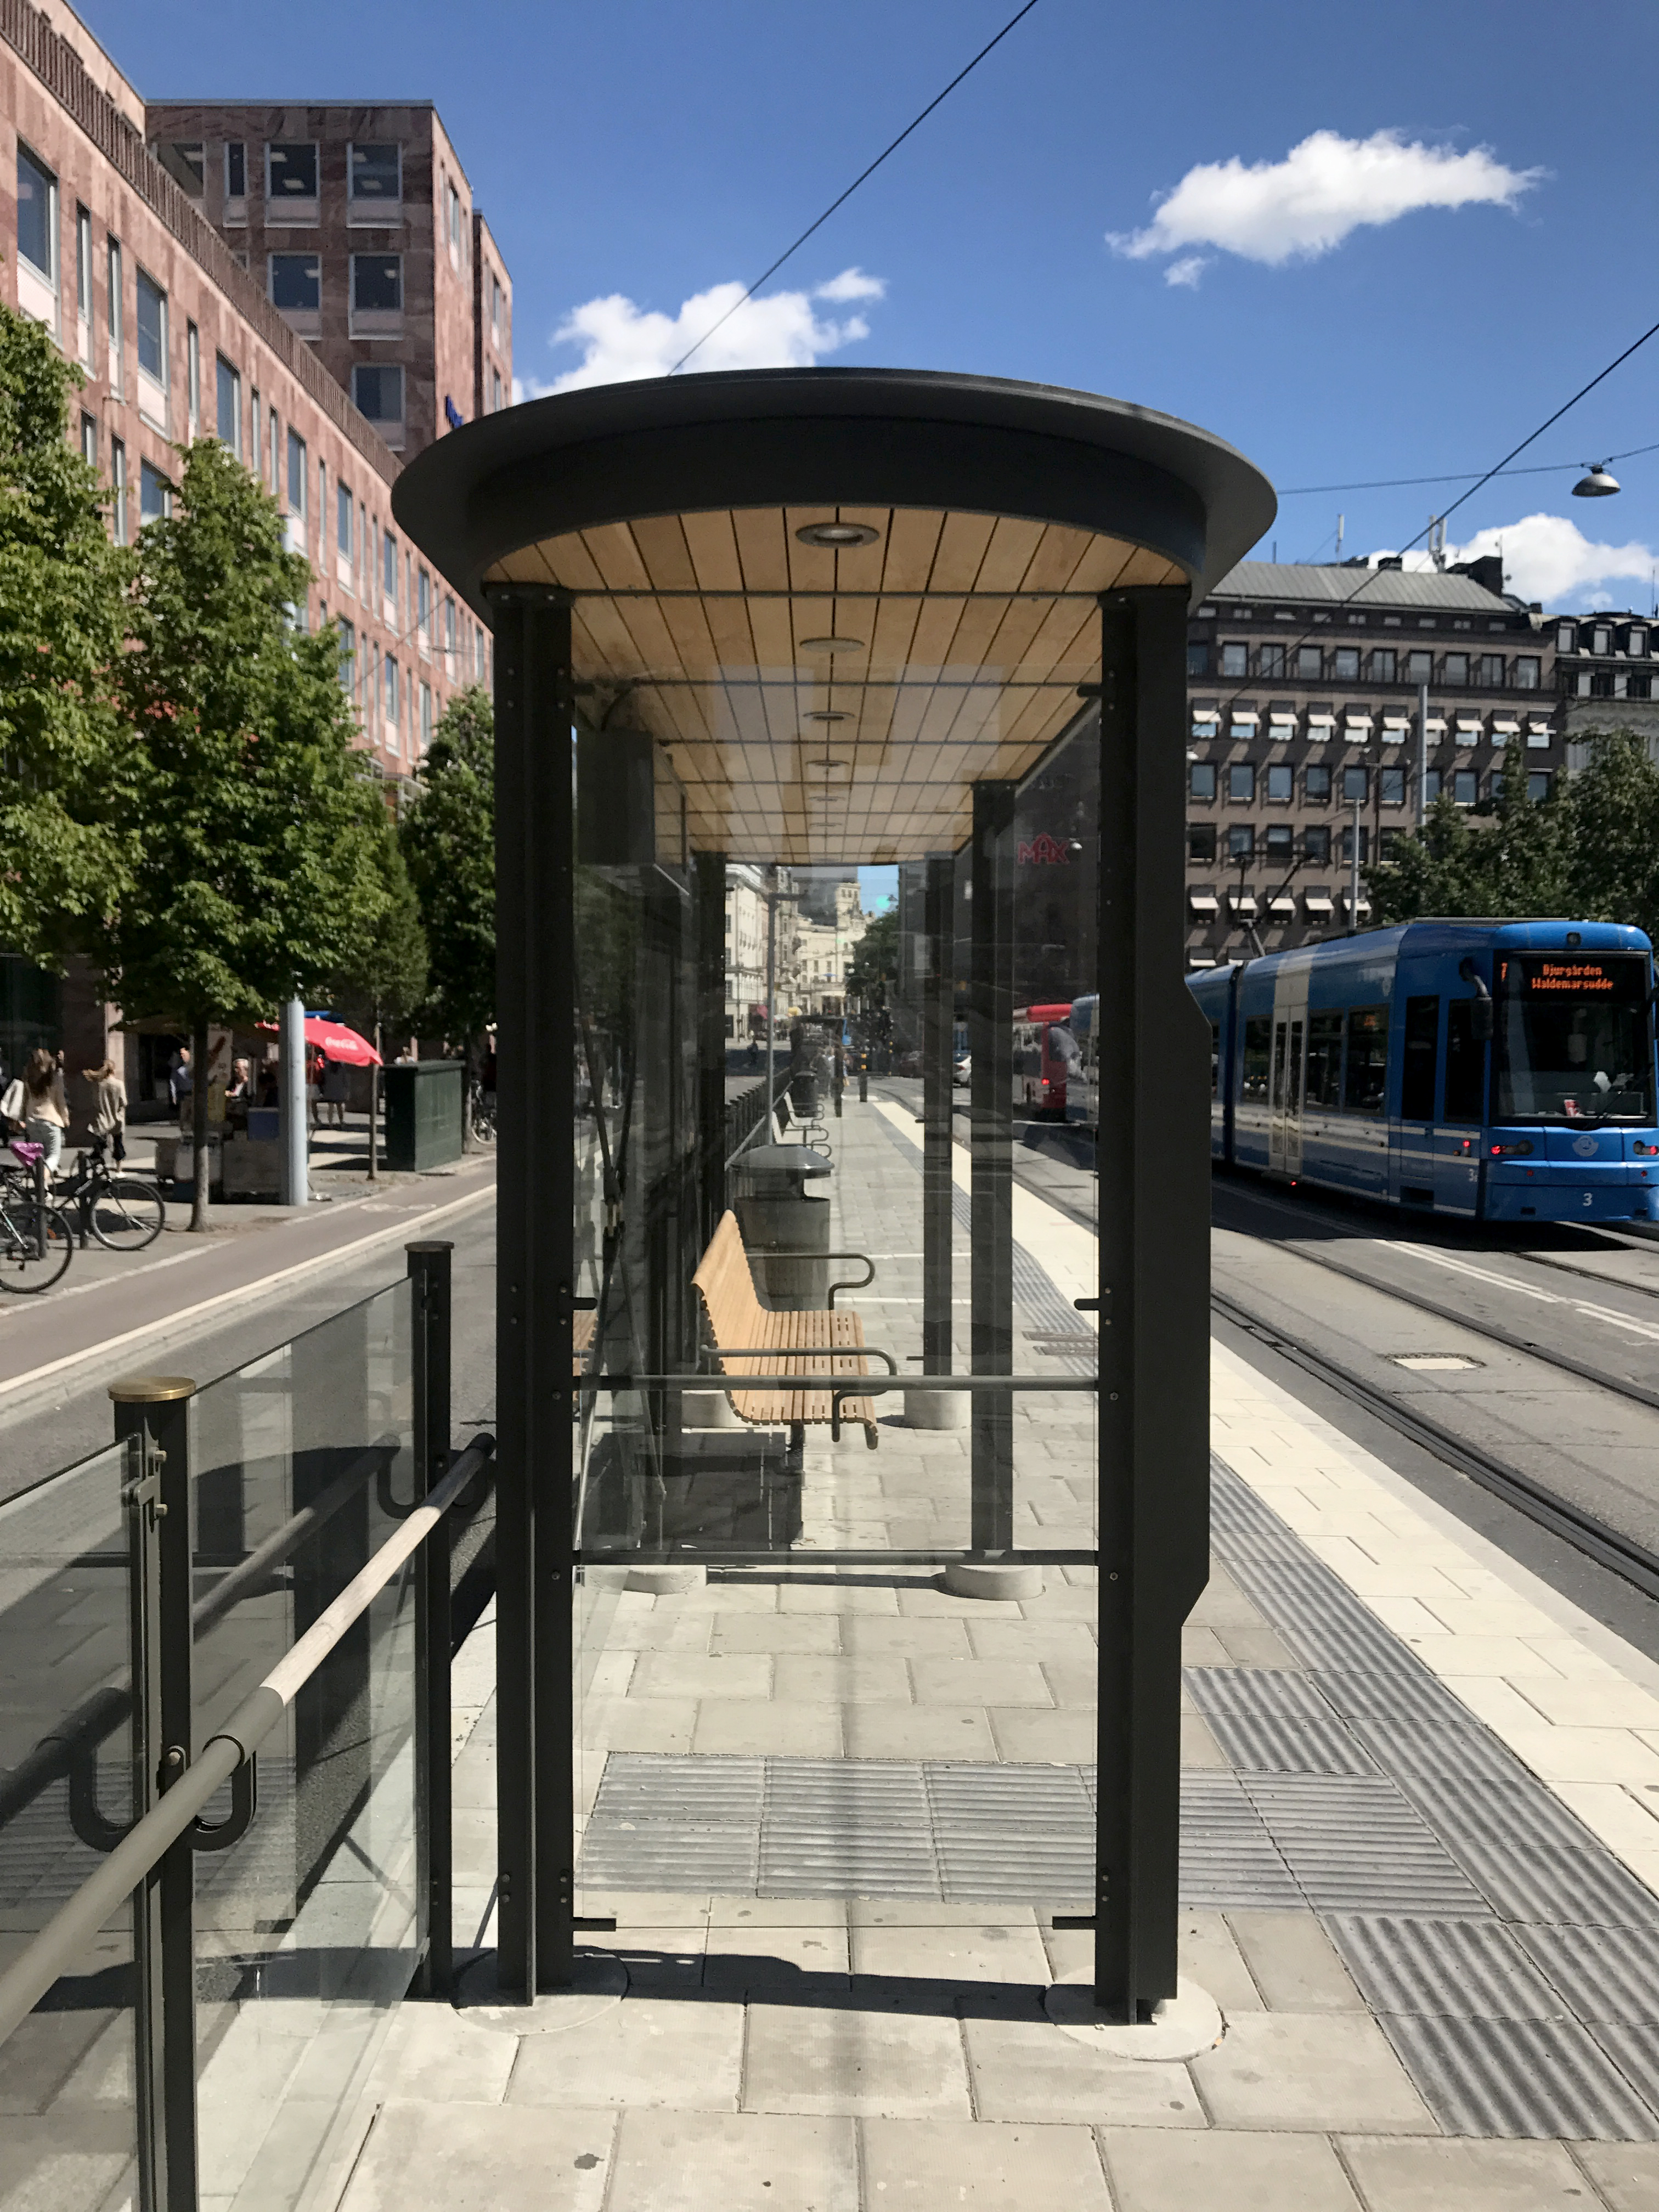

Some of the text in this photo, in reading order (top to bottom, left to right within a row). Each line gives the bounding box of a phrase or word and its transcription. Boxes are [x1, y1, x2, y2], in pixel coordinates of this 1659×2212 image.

[1018, 832, 1070, 865] MAX
[1542, 963, 1602, 977] Djurgården
[1532, 977, 1614, 990] Waldemarsudde
[1583, 1192, 1593, 1206] 3
